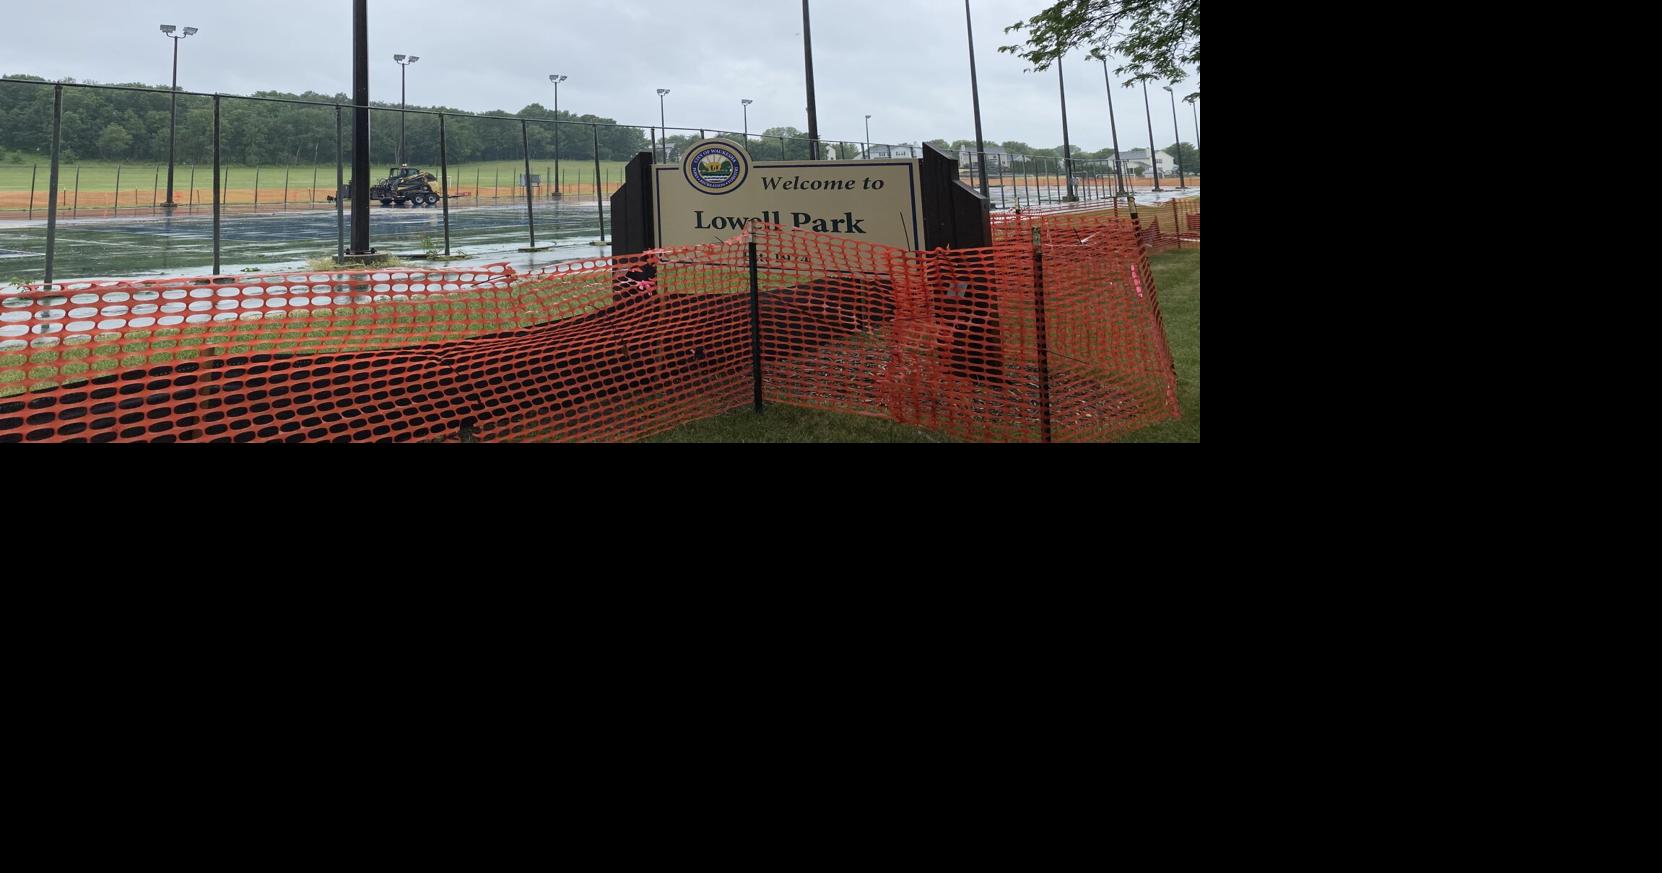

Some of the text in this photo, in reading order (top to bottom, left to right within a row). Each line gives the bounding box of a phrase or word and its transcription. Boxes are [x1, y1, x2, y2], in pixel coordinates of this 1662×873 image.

[761, 176, 885, 190] Welcome to
[694, 210, 867, 234] Lowell Park
